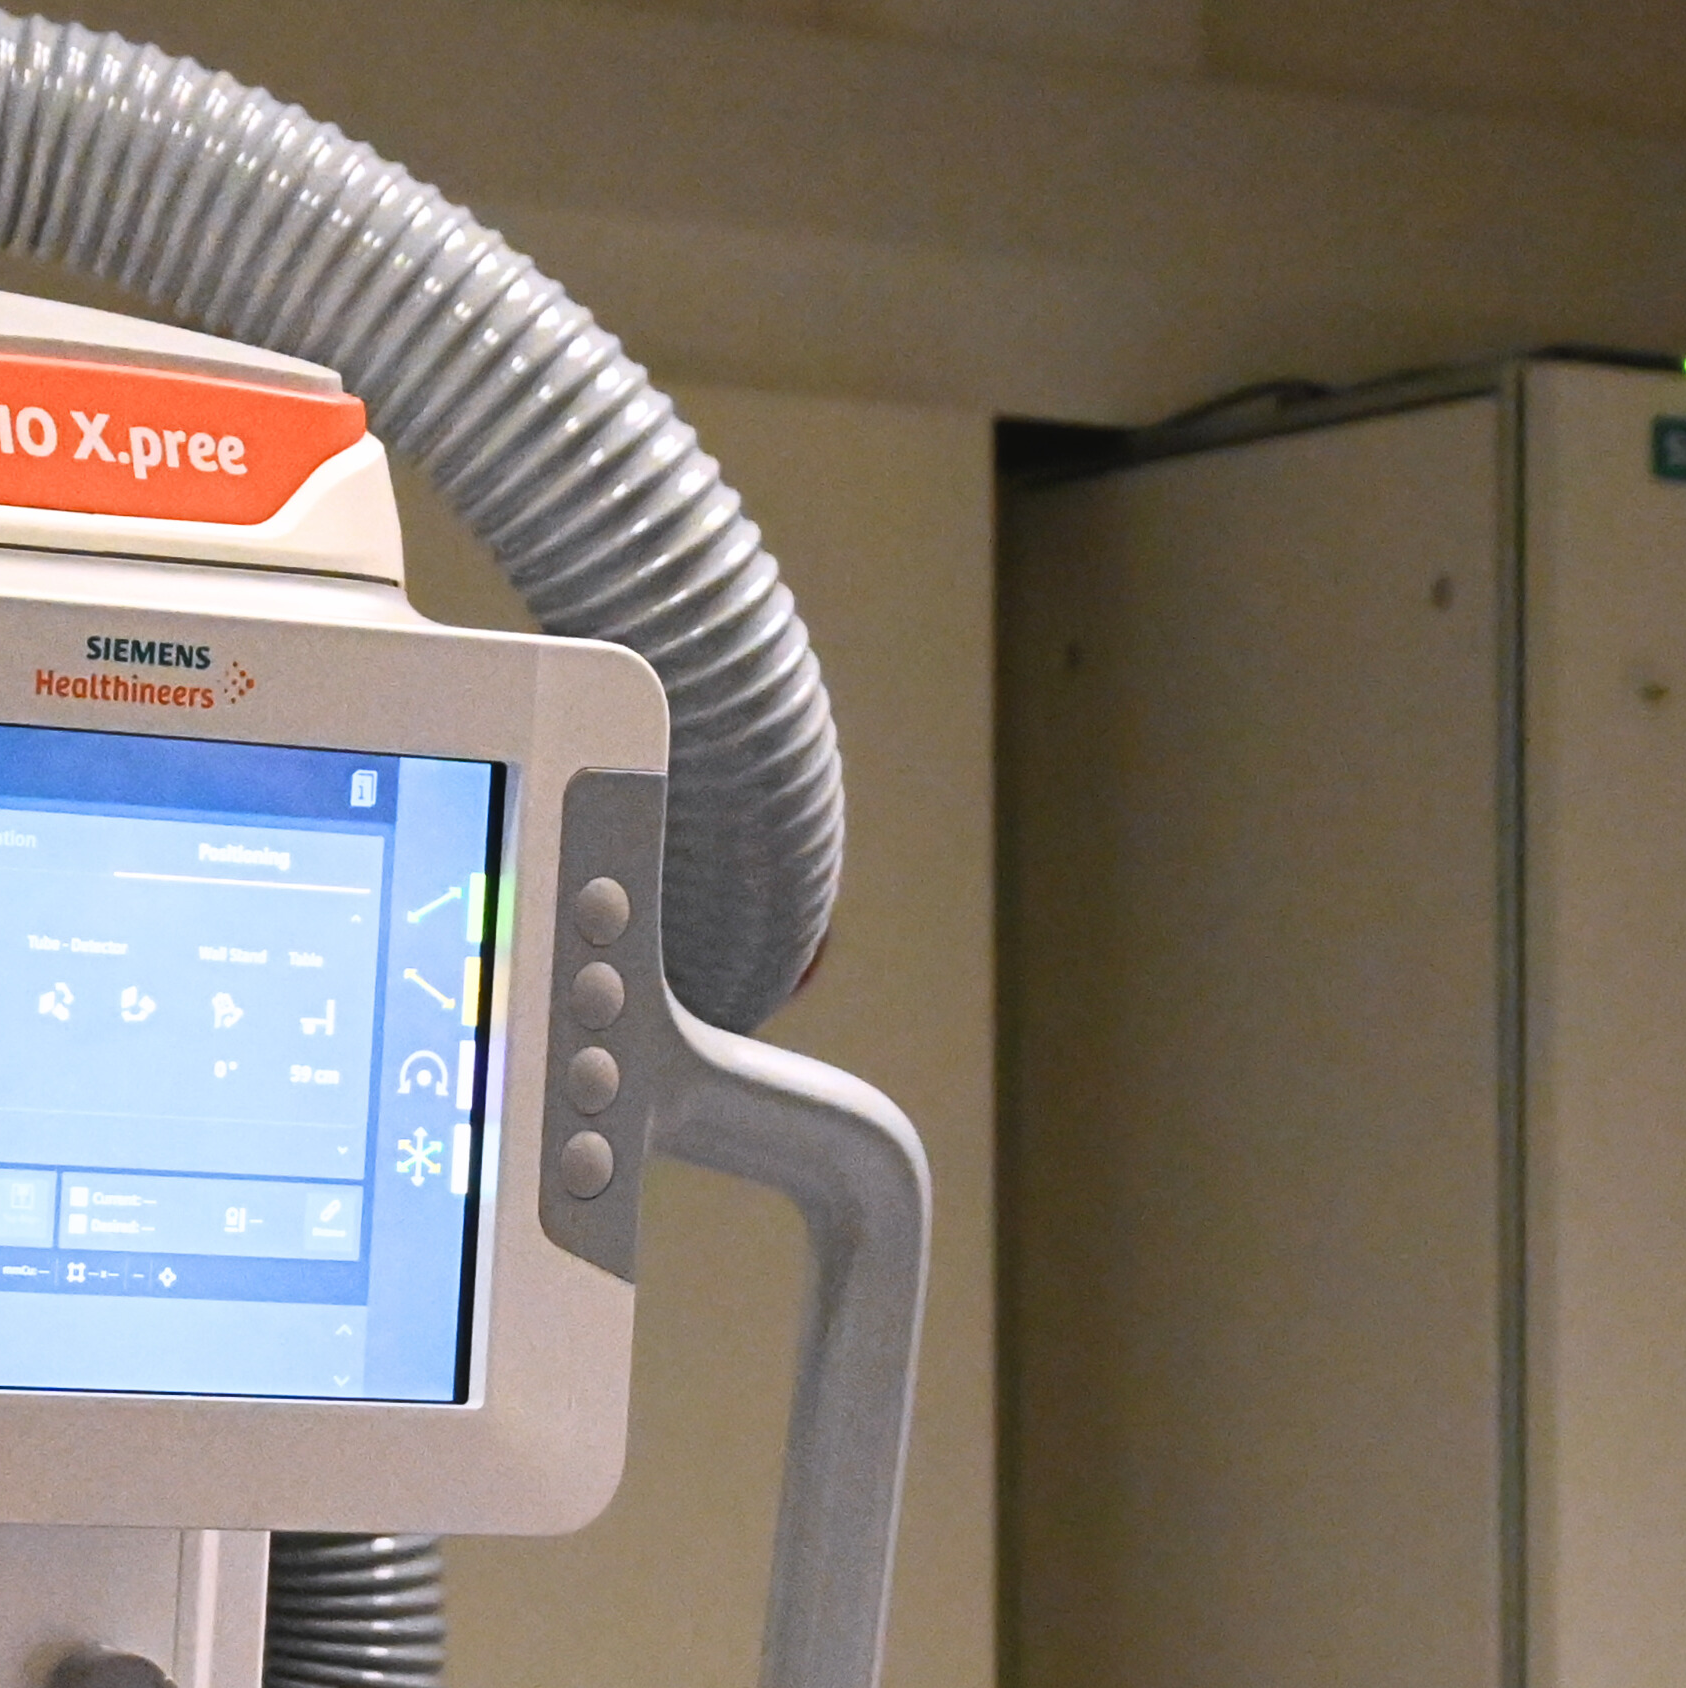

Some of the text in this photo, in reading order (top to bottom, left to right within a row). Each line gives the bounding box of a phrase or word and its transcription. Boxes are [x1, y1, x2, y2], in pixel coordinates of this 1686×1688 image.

[69, 410, 248, 480] X.pree
[86, 635, 211, 670] SIEMENS
[35, 669, 215, 709] Healthineers
[198, 843, 292, 871] Positioning
[27, 934, 61, 951] Tube
[71, 937, 128, 955] Detector
